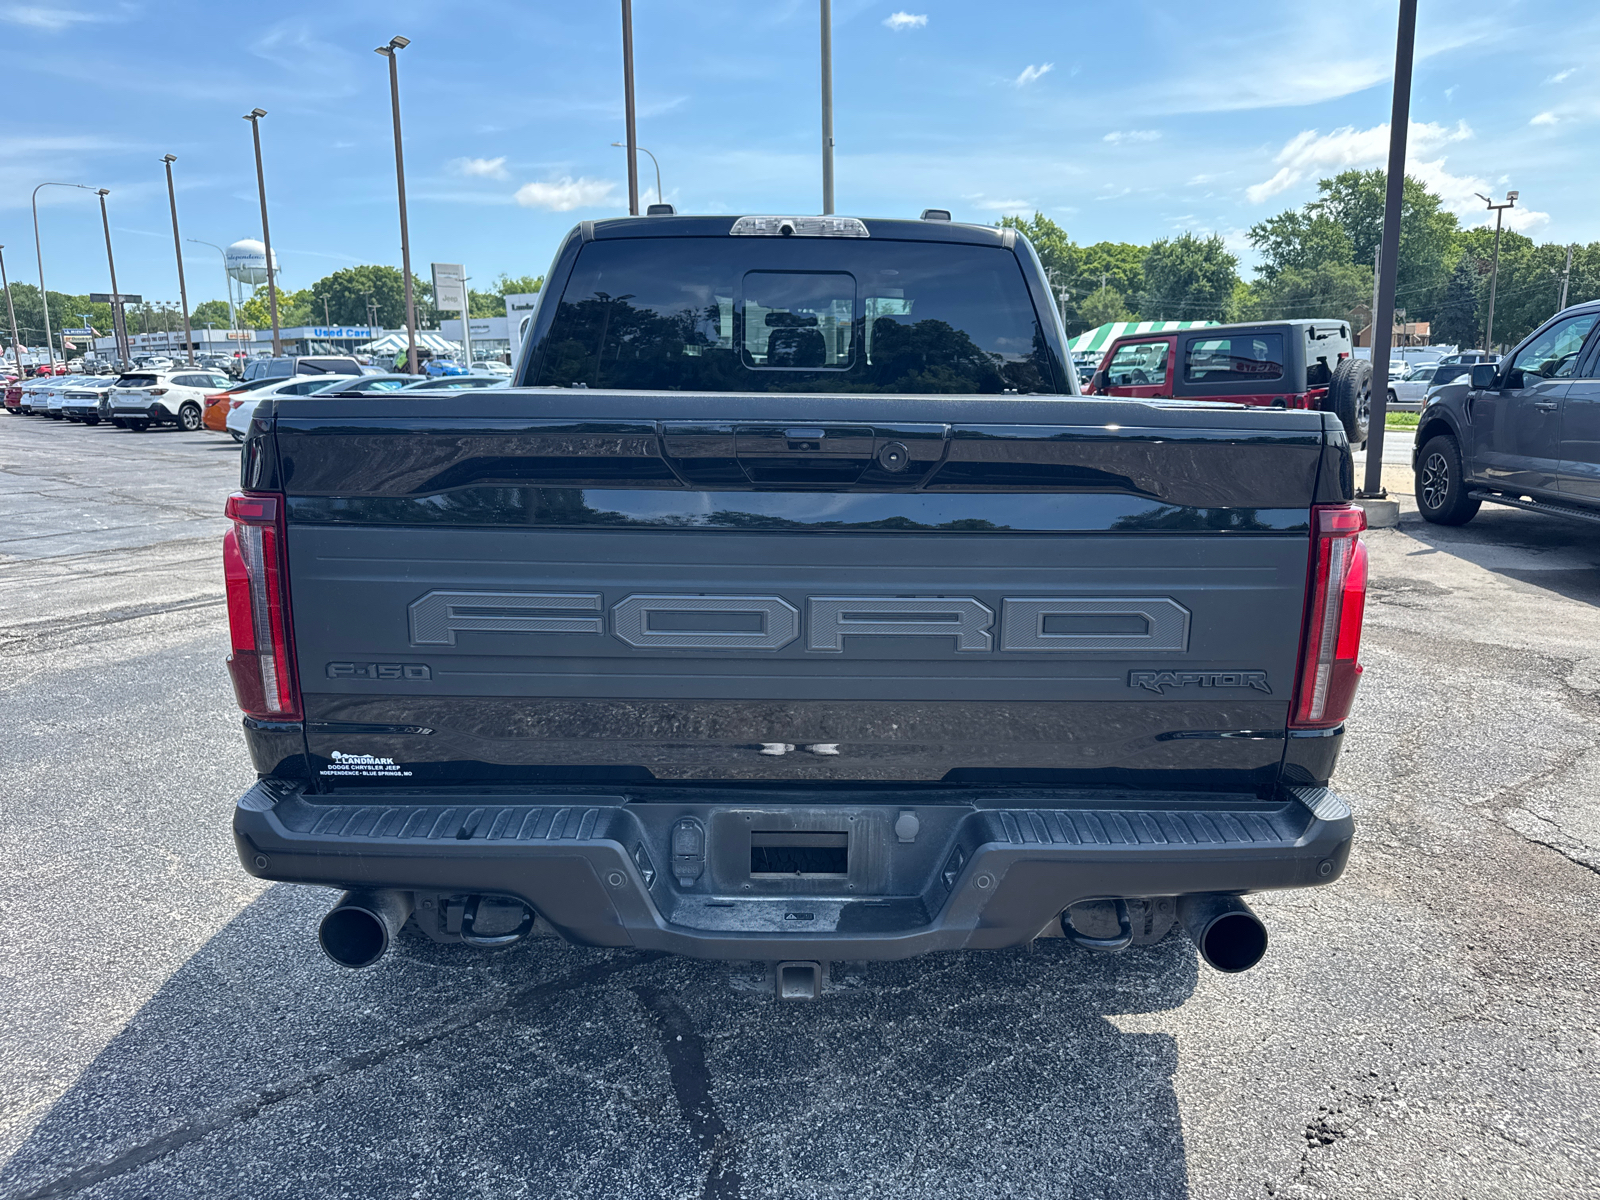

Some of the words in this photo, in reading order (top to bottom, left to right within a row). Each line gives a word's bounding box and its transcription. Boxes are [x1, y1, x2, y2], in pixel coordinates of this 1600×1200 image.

[442, 295, 458, 303] Jeep
[314, 328, 343, 337] Used
[346, 328, 371, 337] Cars
[408, 589, 1192, 653] FORD
[325, 661, 432, 680] F-150
[1128, 669, 1272, 695] RAPTOR
[342, 757, 394, 765] LANDMARK
